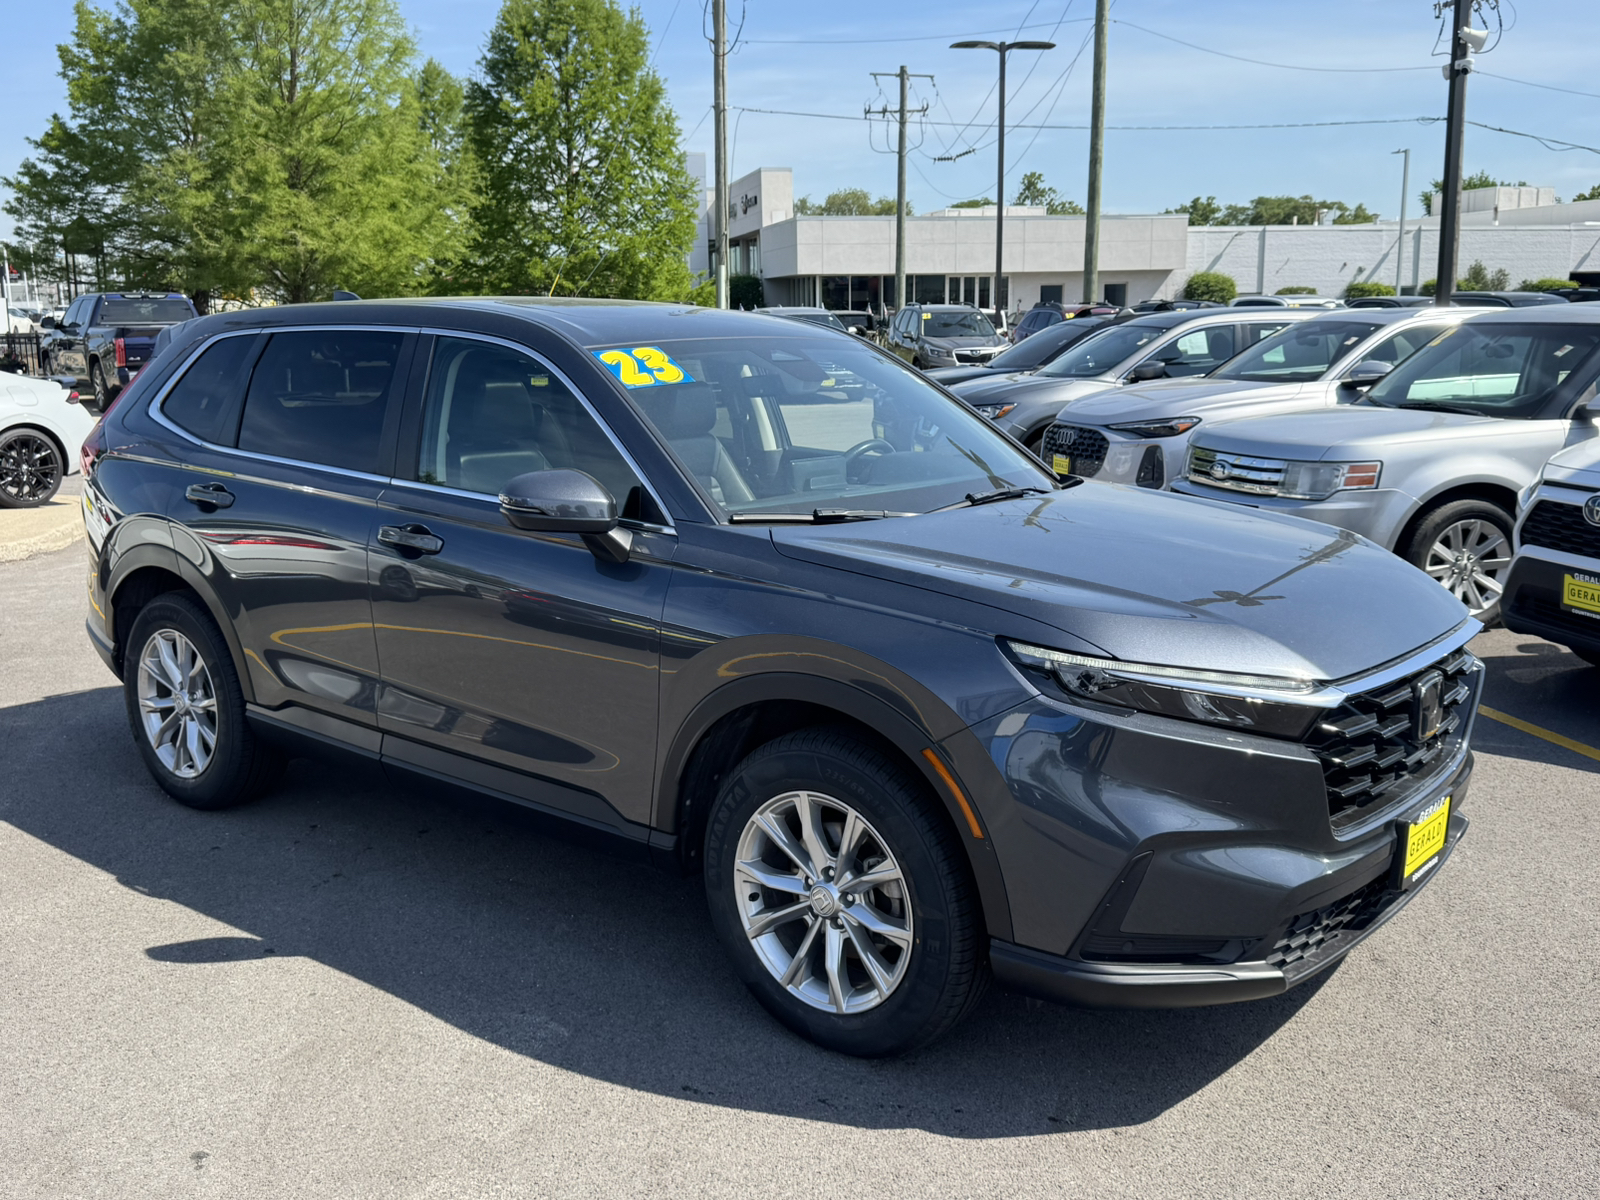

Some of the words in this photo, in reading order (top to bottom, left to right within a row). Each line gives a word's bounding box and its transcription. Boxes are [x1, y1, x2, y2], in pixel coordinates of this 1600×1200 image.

[600, 346, 685, 386] 23
[1418, 797, 1445, 822] GERALD
[1410, 822, 1442, 857] GERALD
